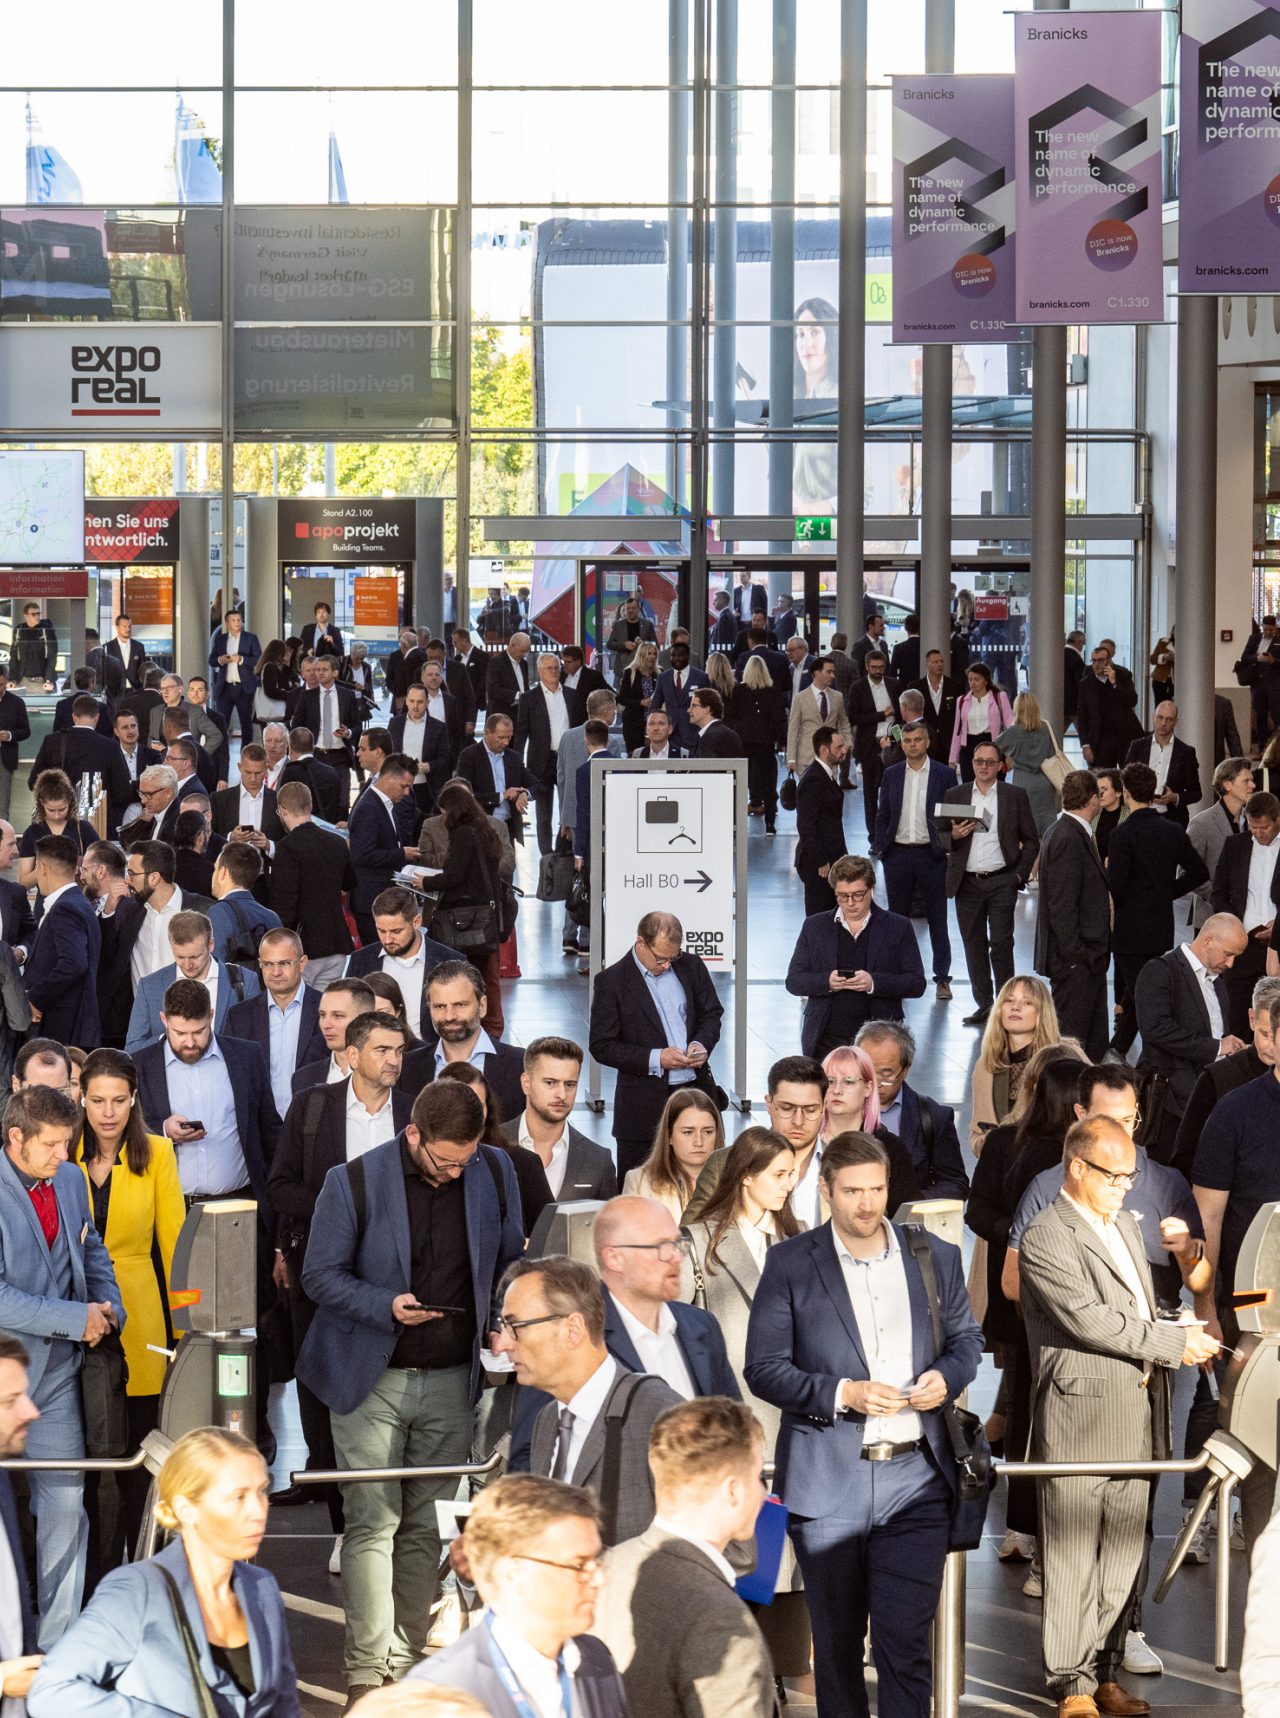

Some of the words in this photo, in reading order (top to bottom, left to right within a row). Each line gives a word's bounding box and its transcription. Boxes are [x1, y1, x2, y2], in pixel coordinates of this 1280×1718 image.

[1027, 27, 1088, 41] Branicks
[1206, 61, 1239, 78] The
[903, 89, 955, 101] Branicks
[1205, 85, 1257, 98] name
[1035, 130, 1063, 143] The
[1067, 132, 1099, 143] new
[1035, 149, 1078, 160] name
[1081, 146, 1098, 160] of
[1035, 164, 1100, 182] dynamic
[909, 177, 934, 188] The
[936, 178, 964, 188] new
[1035, 180, 1140, 198] performance.
[909, 193, 945, 203] name
[948, 190, 962, 203] of
[909, 206, 965, 221] dynamic
[909, 220, 998, 236] performance.
[1089, 238, 1106, 249] DIC
[1106, 236, 1114, 245] is
[1116, 234, 1133, 244] now
[1096, 245, 1130, 257] Branicks
[955, 269, 969, 280] DIC
[970, 268, 977, 276] is
[977, 266, 993, 276] now
[1195, 264, 1269, 276] branicks.com
[960, 275, 990, 287] Branicks
[1029, 298, 1090, 309] branicks.com
[1107, 296, 1150, 308] C1.330
[903, 322, 956, 331] branicks.com
[969, 320, 1006, 331] C1.330
[71, 346, 161, 383] expo
[322, 508, 344, 517] Stand
[345, 508, 373, 517] A2.100
[116, 513, 140, 528] Sie
[143, 516, 169, 528] uns
[312, 522, 400, 540] apoprojekt
[332, 544, 361, 553] Building
[361, 543, 385, 552] Teams.
[9, 574, 65, 583] Information
[9, 584, 65, 594] Information
[976, 597, 1007, 605] Ausgang
[623, 873, 653, 888] Hall
[658, 873, 679, 888] B0
[685, 931, 724, 947] expo
